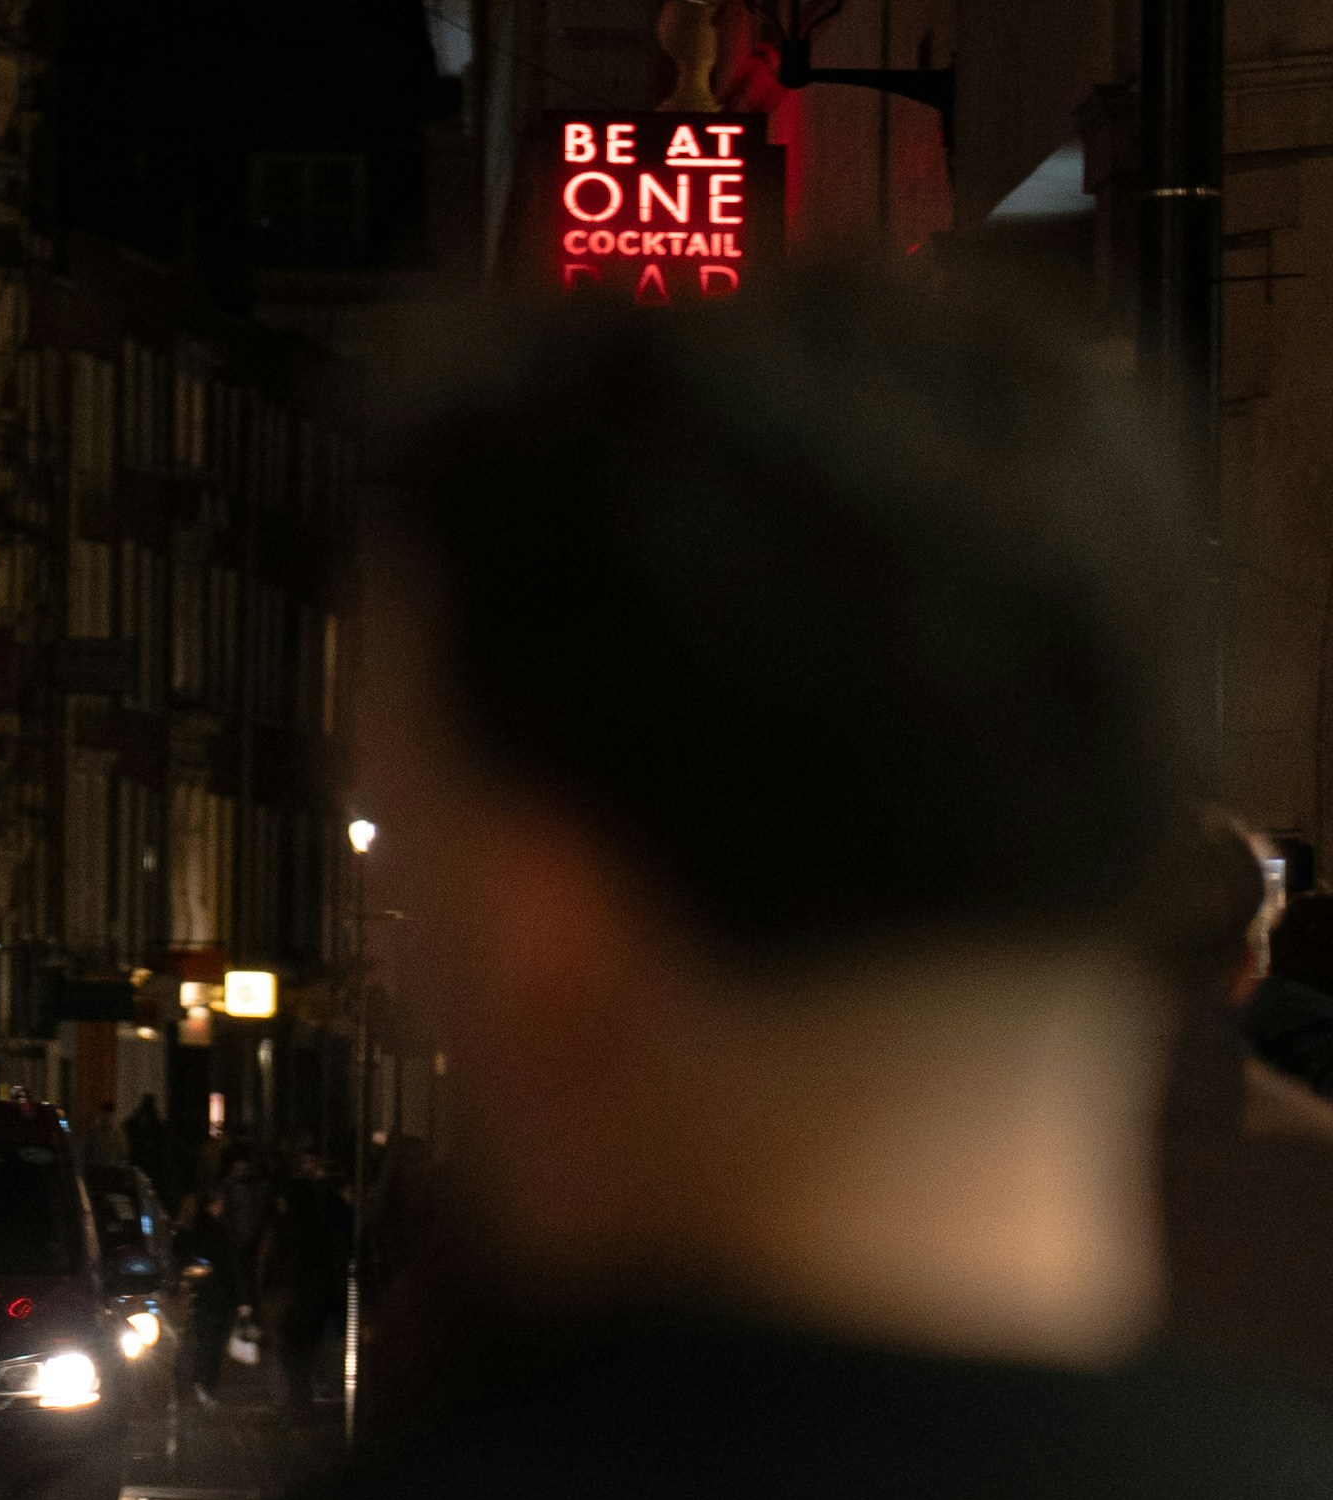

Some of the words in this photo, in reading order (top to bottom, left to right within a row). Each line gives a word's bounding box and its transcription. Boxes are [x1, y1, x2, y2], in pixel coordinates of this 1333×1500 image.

[563, 122, 637, 164] BE
[665, 124, 745, 159] AT
[562, 170, 744, 225] ONE
[562, 229, 743, 258] COCKTAIL
